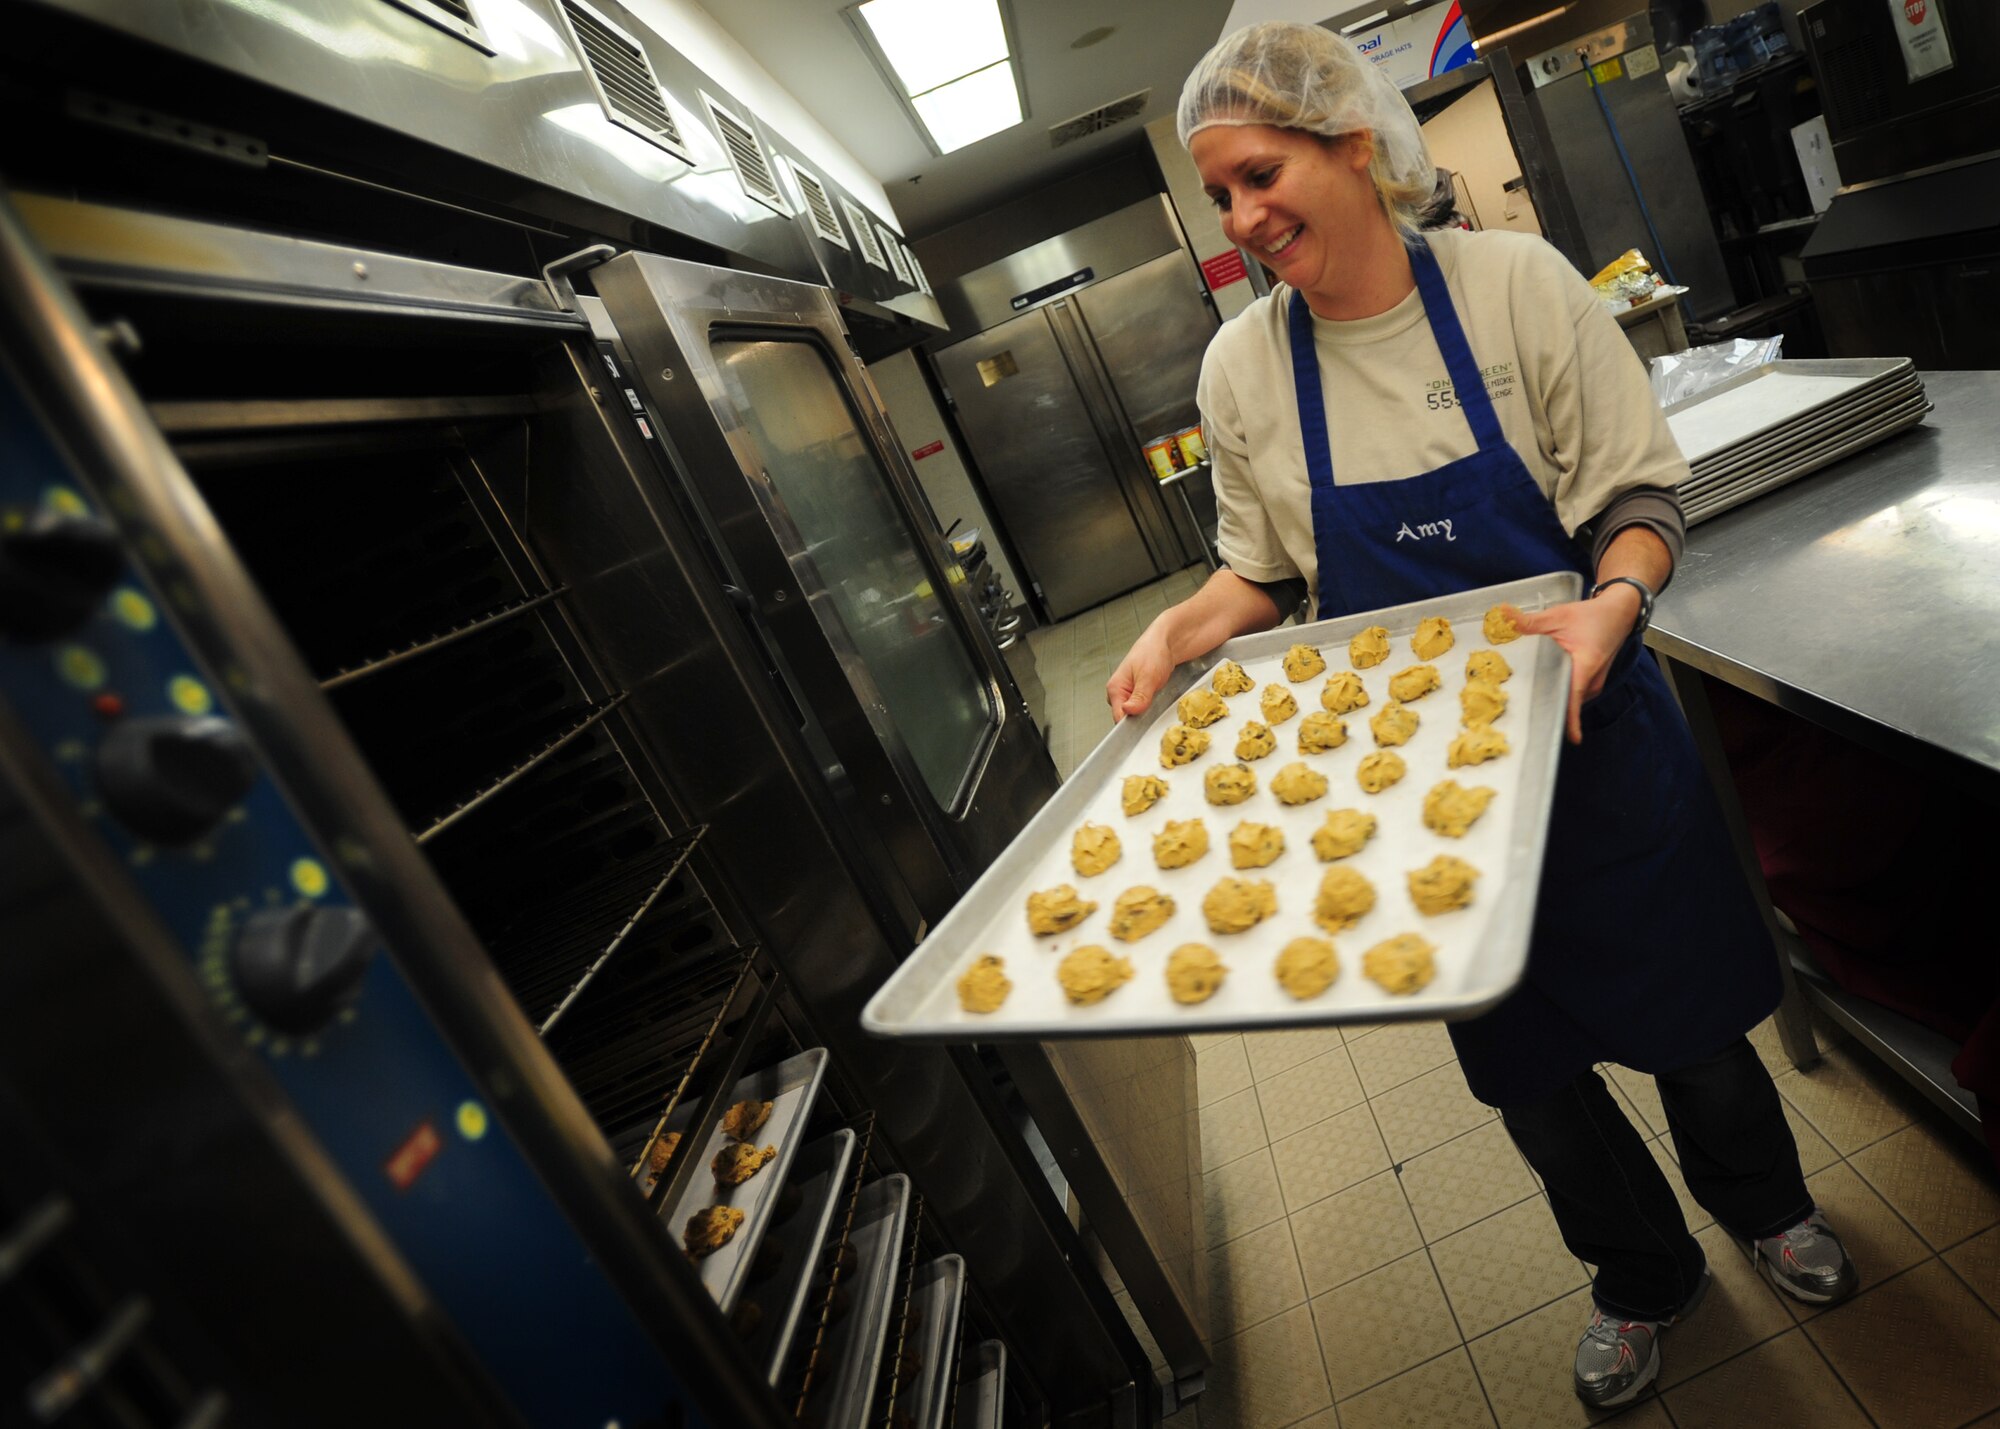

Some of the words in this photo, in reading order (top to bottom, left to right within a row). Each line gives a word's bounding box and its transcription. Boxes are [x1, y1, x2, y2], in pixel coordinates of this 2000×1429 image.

[1905, 1, 1924, 18] STOP
[1395, 42, 1412, 53] HATS
[1396, 519, 1457, 542] Amy
